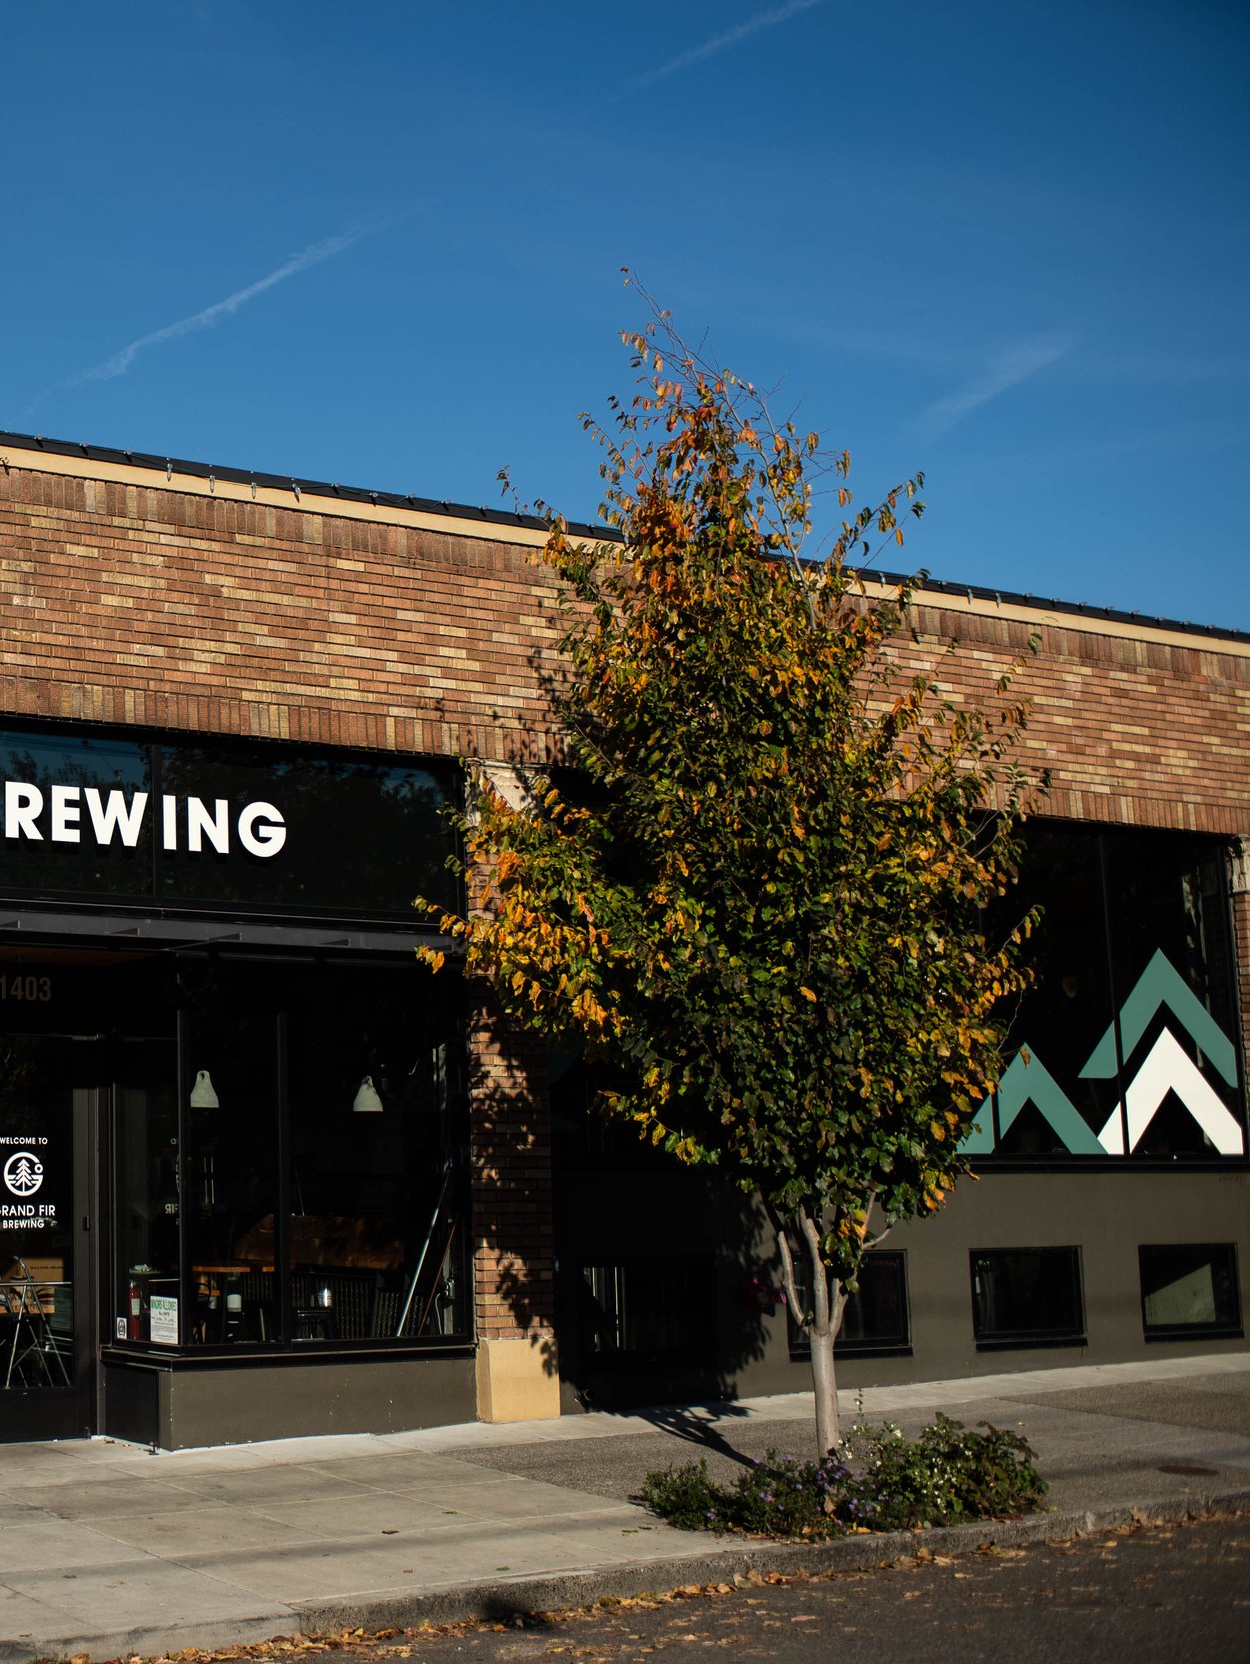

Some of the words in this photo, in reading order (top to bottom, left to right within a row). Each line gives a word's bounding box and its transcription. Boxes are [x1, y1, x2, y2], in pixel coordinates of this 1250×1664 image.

[0, 1136, 36, 1145] WELCOME
[38, 1137, 48, 1145] TO
[38, 1204, 56, 1216] FIR
[2, 1219, 45, 1229] BREWING
